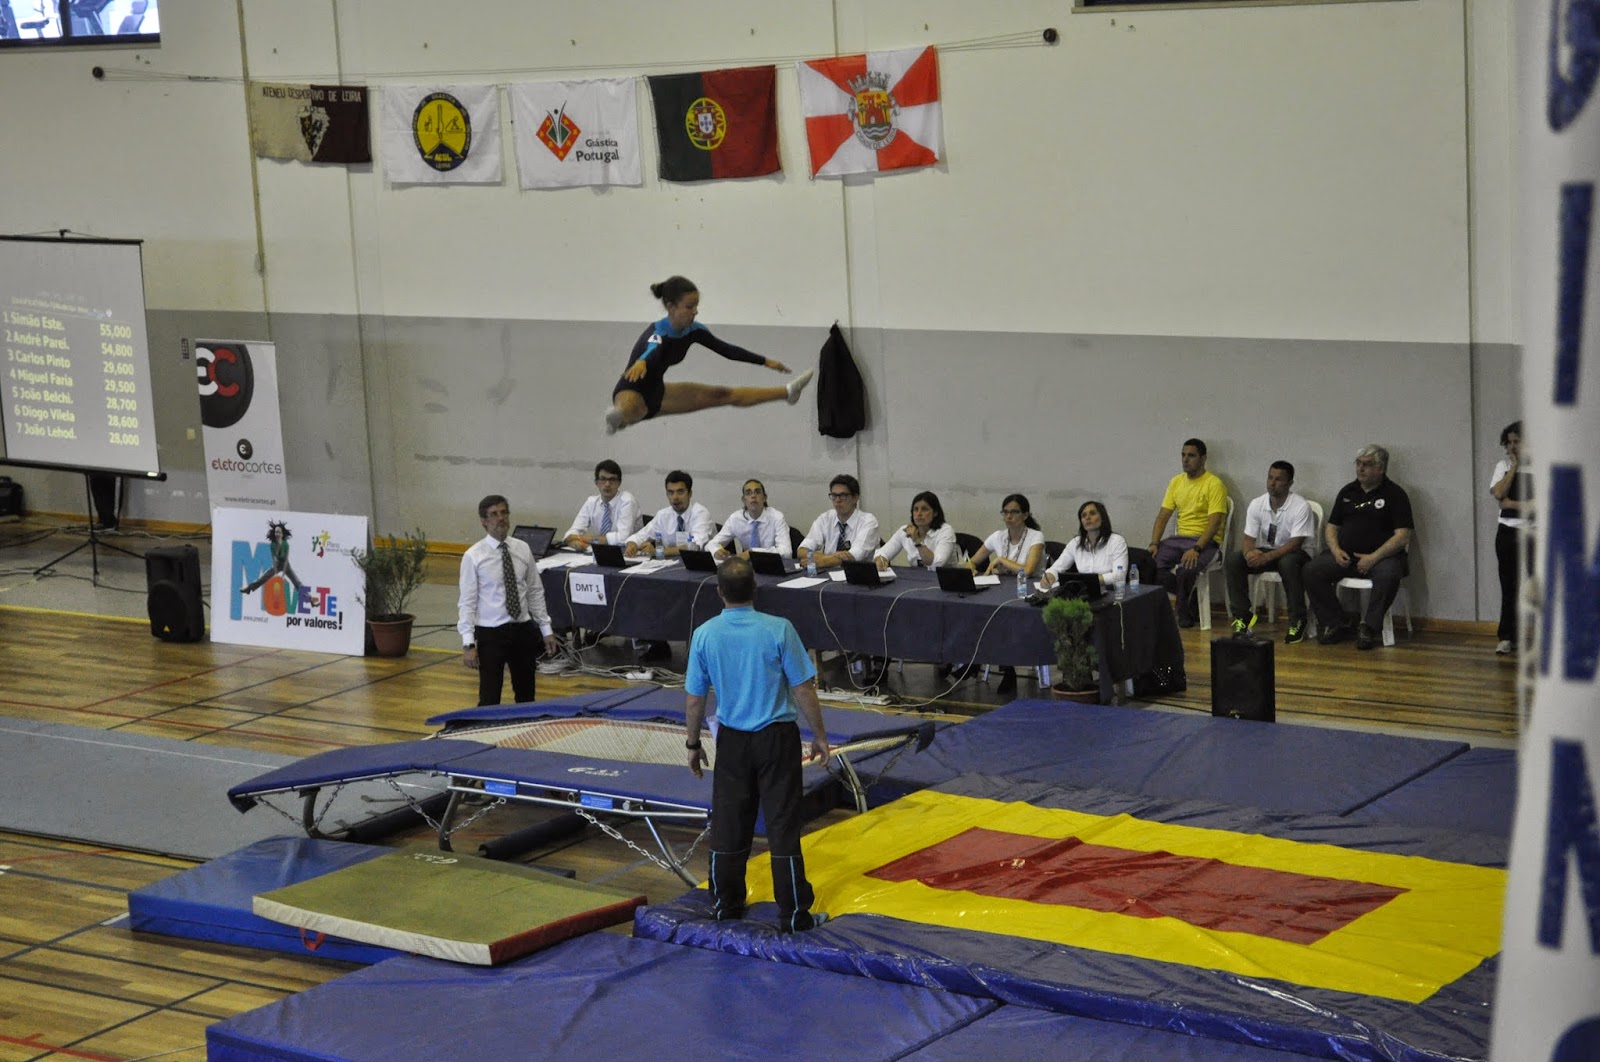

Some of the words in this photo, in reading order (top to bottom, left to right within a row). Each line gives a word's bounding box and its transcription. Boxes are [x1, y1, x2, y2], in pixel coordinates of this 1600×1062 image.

[328, 90, 337, 101] DE
[3, 311, 9, 323] 1
[10, 312, 40, 327] Simão
[99, 323, 132, 339] 55,000
[5, 330, 12, 342] 2
[13, 331, 41, 346] André
[101, 342, 133, 357] 54,800
[7, 349, 14, 361] 3
[15, 350, 45, 366] Carlos
[46, 354, 71, 369] Pinto
[103, 361, 134, 375] 29,600
[9, 368, 16, 379] 4
[17, 369, 49, 385] Miguel
[50, 373, 73, 387] Faria
[104, 379, 136, 393] 29,500
[12, 386, 18, 398] 5
[20, 387, 41, 400] João
[106, 397, 137, 411] 28,700
[14, 404, 20, 416] 6
[21, 405, 49, 421] Diogo
[50, 408, 75, 422] Vilela
[107, 415, 138, 429] 28,600
[16, 422, 22, 433] 7
[24, 423, 46, 436] João
[108, 432, 140, 446] 28,000
[211, 458, 282, 474] eletrocortes
[575, 583, 593, 592] DMT
[286, 616, 302, 628] por
